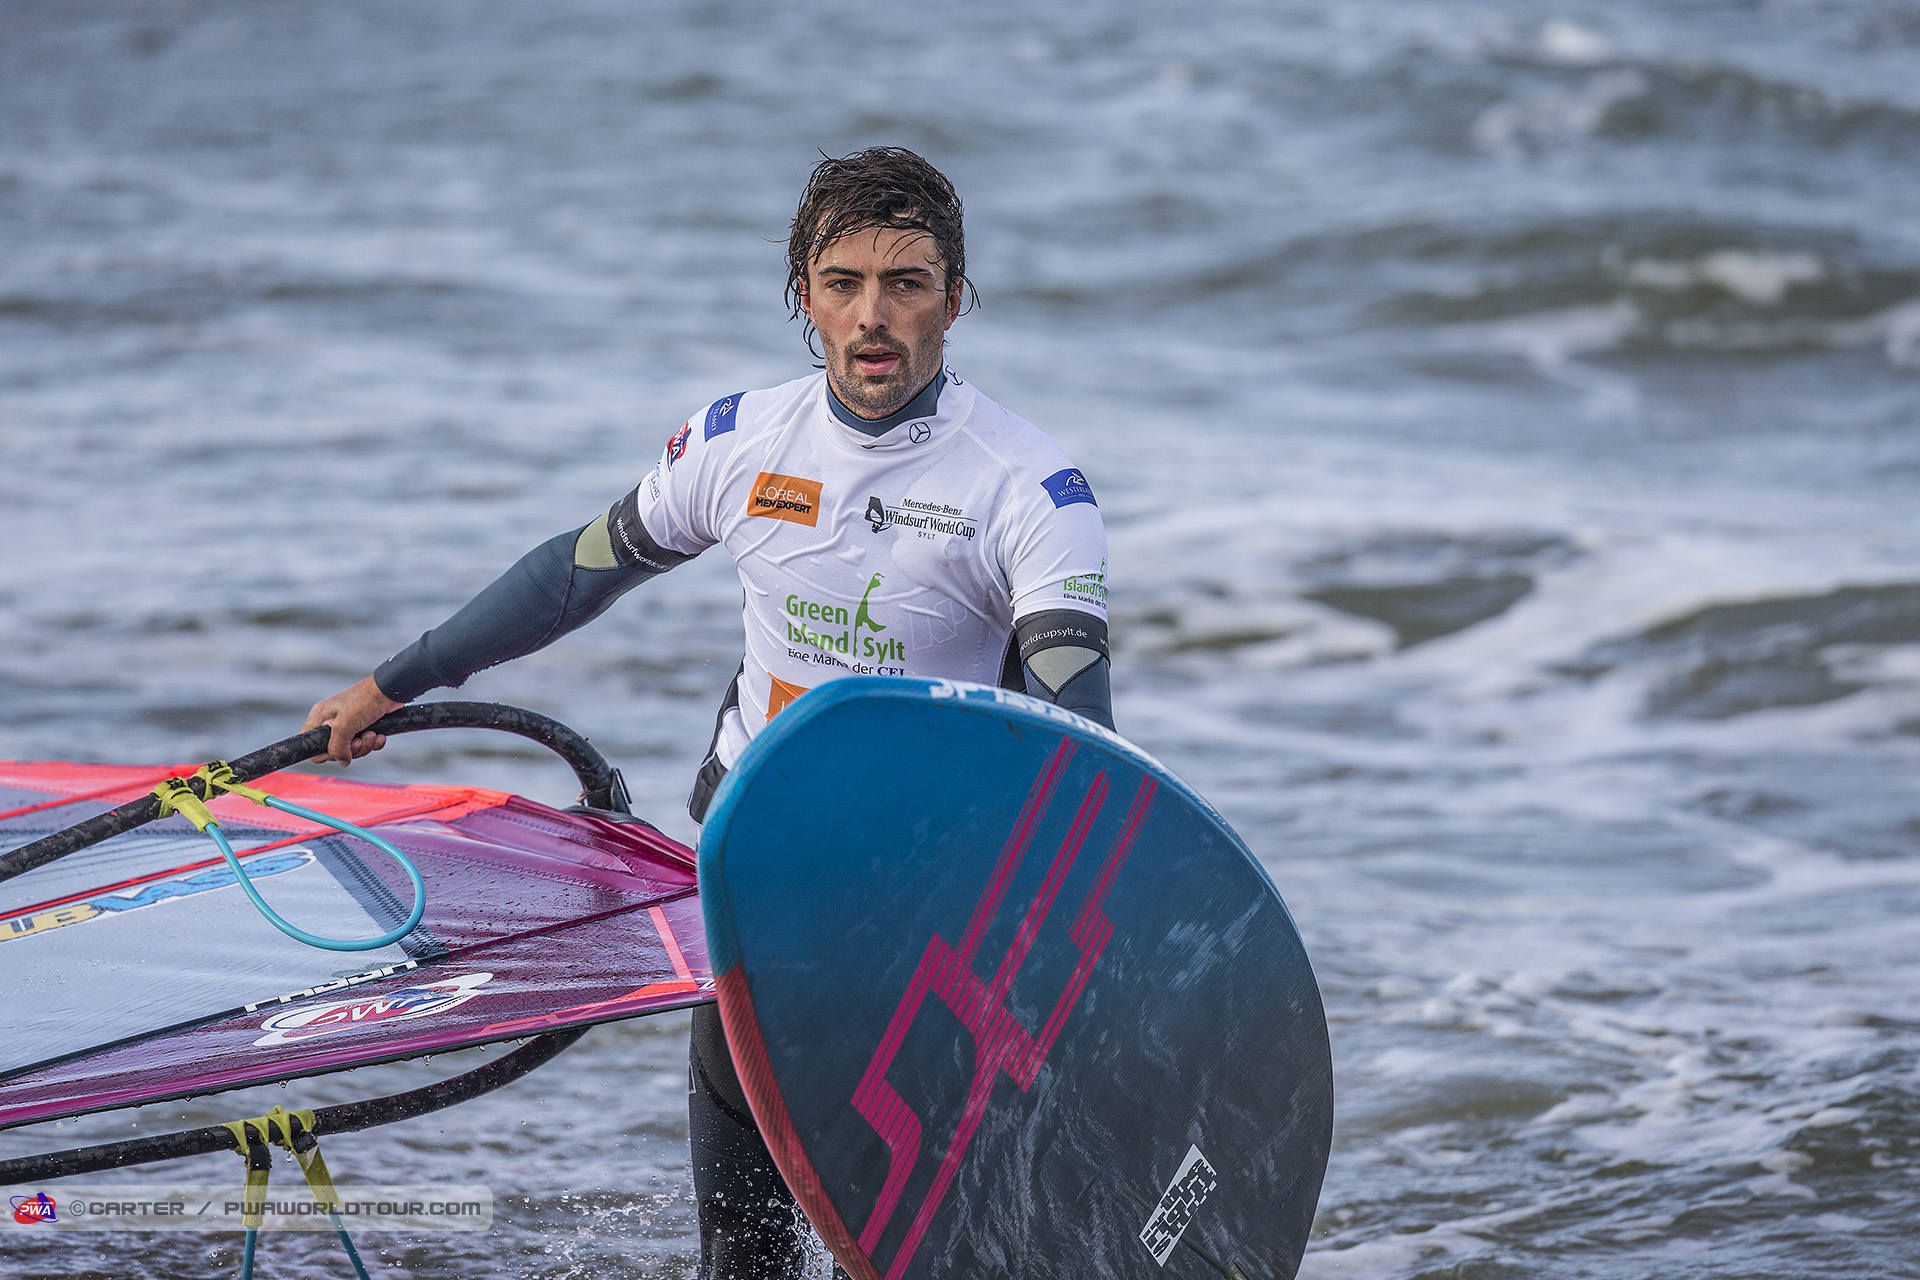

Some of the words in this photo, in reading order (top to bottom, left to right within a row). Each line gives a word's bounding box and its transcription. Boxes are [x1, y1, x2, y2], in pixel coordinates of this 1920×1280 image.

[756, 486, 813, 505] L'ORÉAL
[902, 498, 963, 515] Mercedes-Benz
[884, 510, 930, 529] Windsurf
[930, 516, 955, 535] World
[955, 522, 976, 541] Cup
[917, 531, 936, 541] SYLT
[1063, 579, 1096, 596] Island
[786, 594, 848, 626] Green
[787, 621, 849, 654] Island
[863, 636, 906, 665] Sylt
[788, 647, 810, 662] Eine
[852, 662, 874, 675] der
